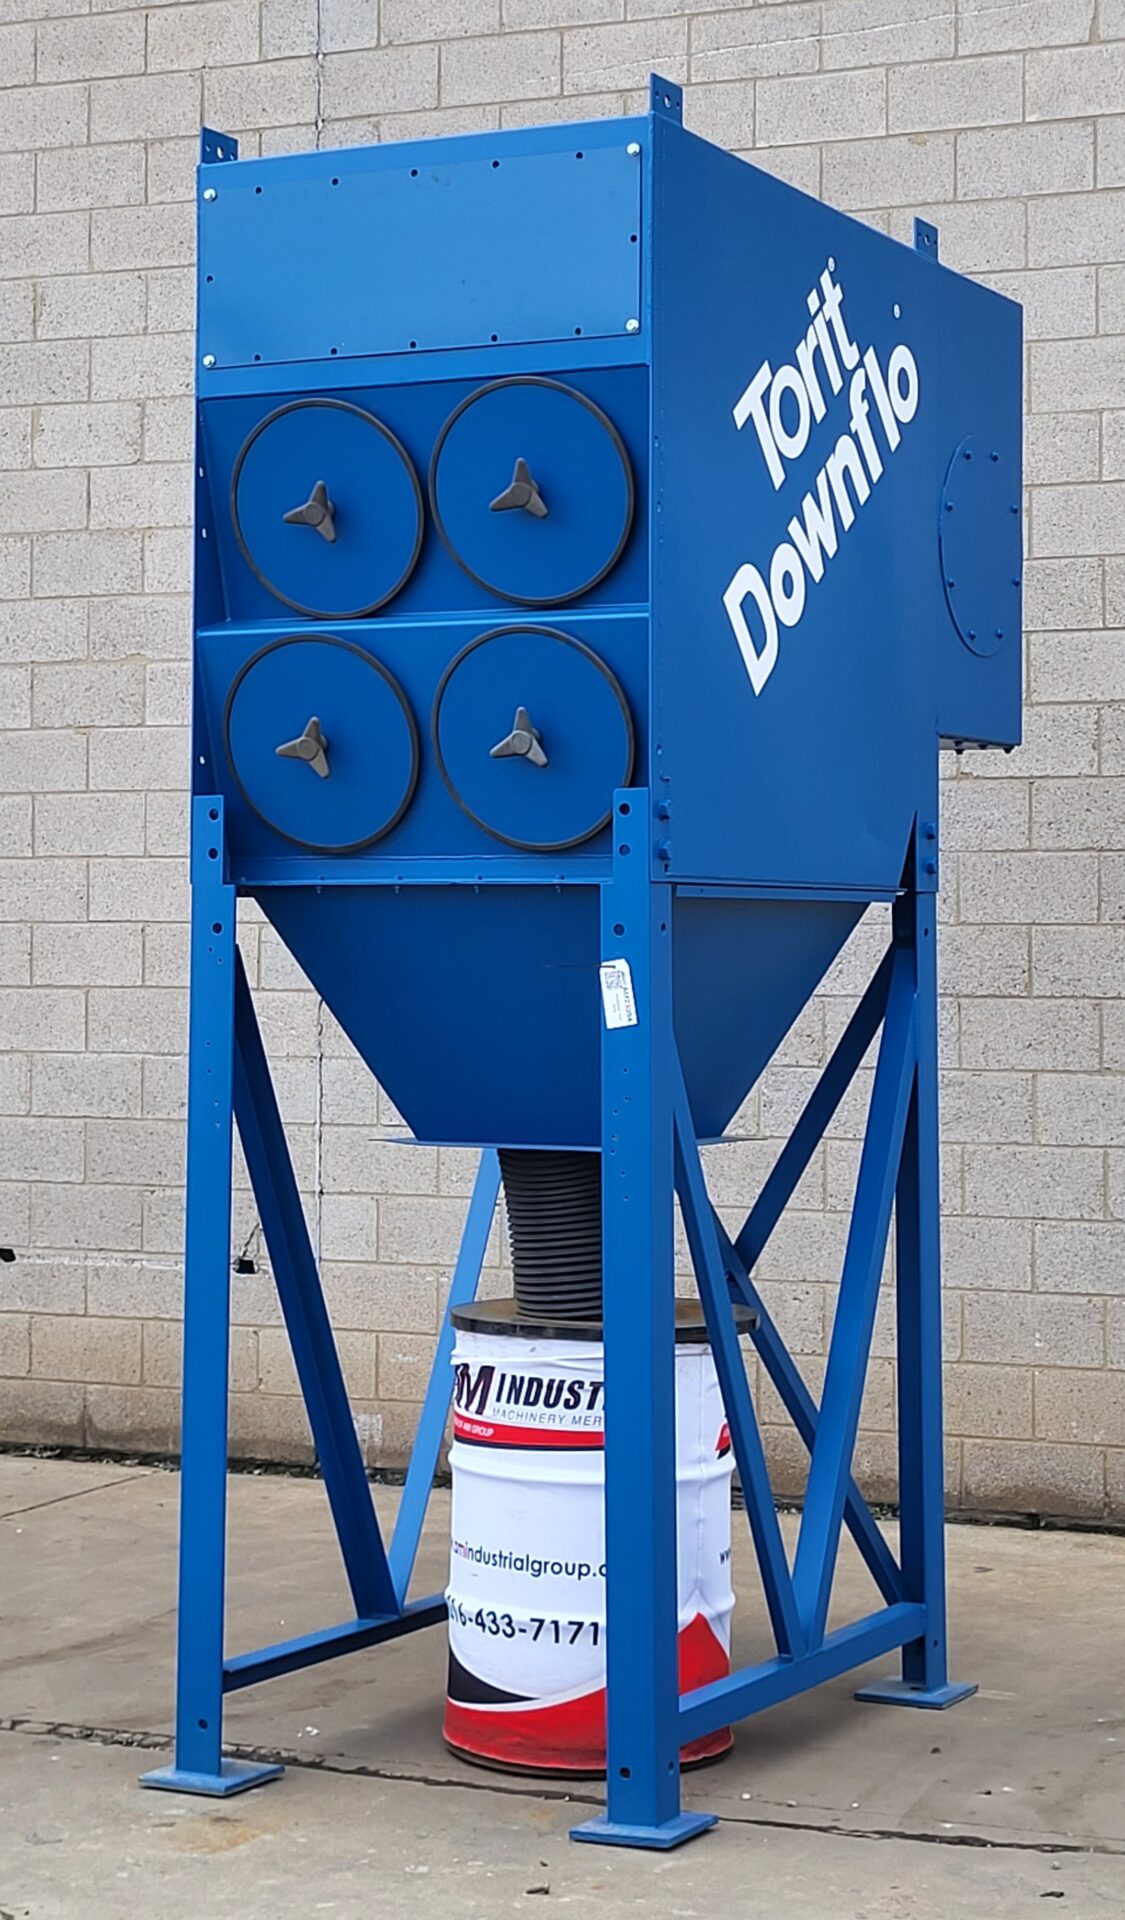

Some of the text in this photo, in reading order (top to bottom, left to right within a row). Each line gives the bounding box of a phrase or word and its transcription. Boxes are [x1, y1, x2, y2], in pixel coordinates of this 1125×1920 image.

[732, 268, 860, 492] Torit
[722, 344, 919, 697] Downflo
[493, 1407, 566, 1425] MACHINERY
[496, 1373, 605, 1411] INDUST
